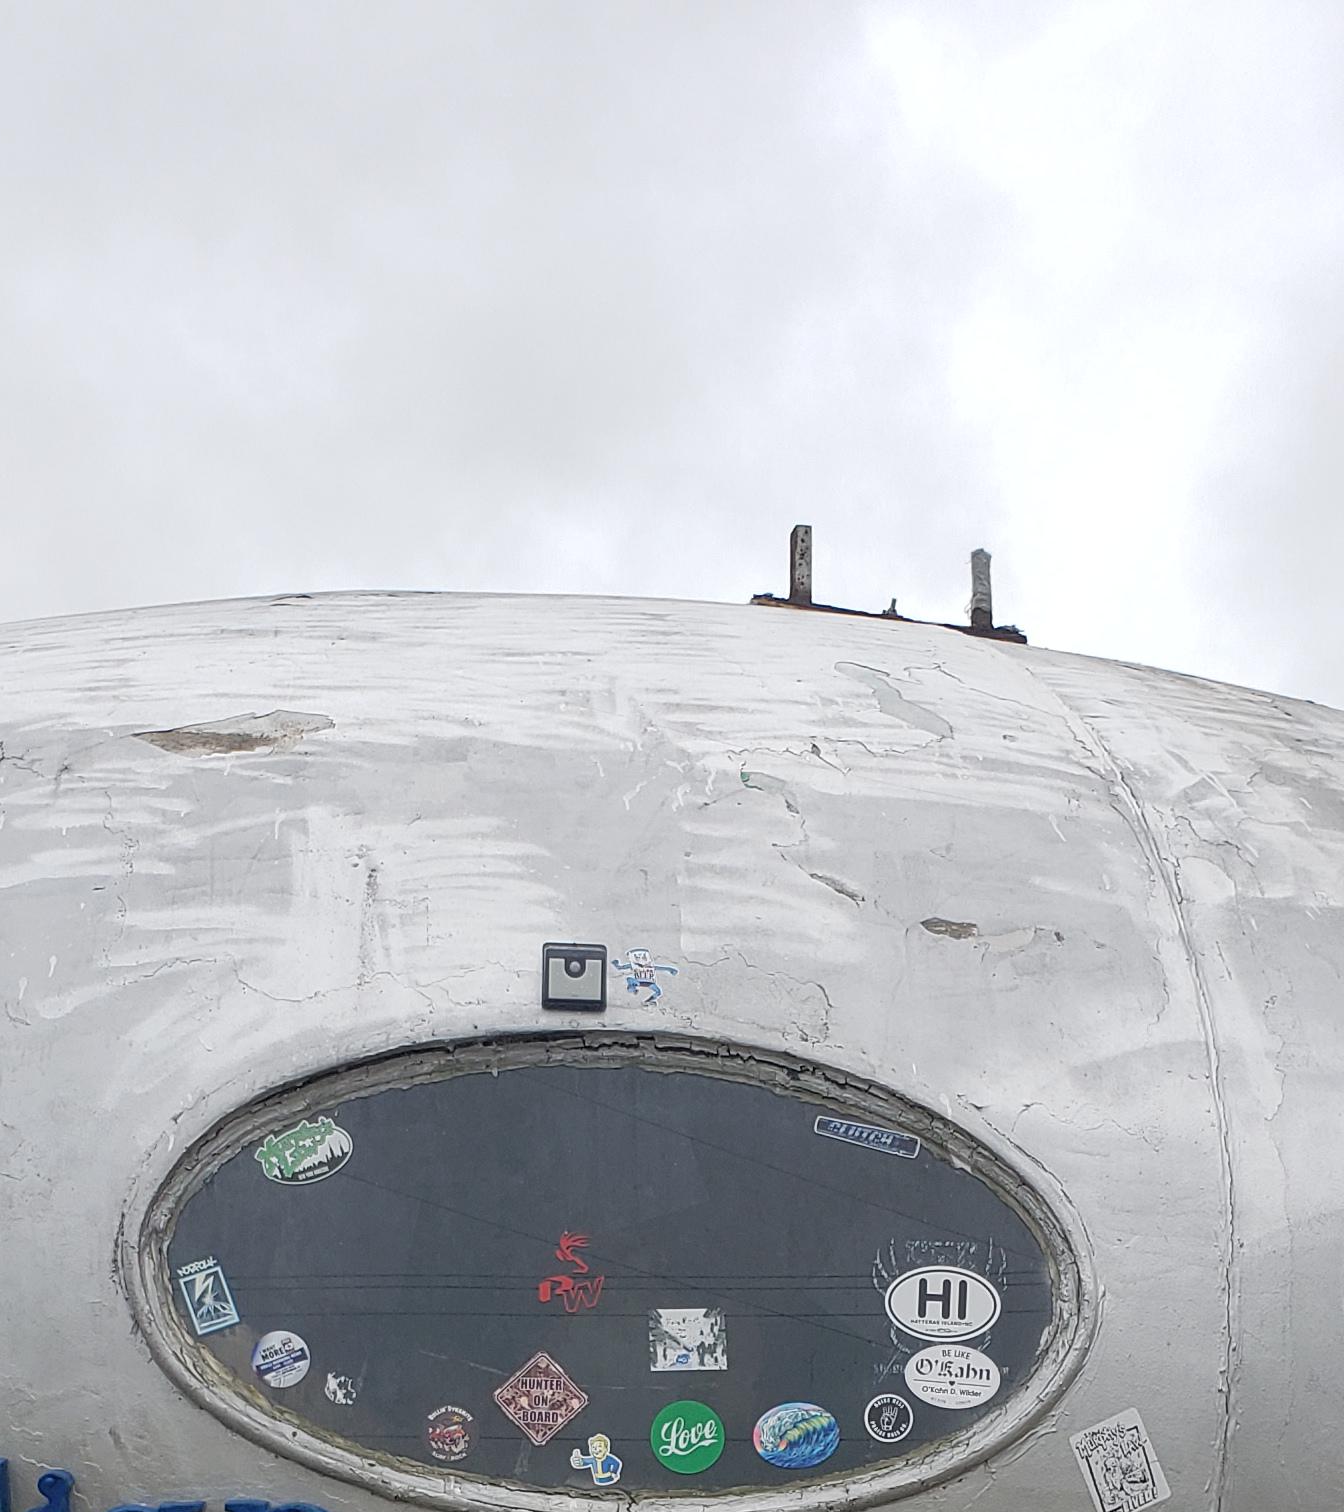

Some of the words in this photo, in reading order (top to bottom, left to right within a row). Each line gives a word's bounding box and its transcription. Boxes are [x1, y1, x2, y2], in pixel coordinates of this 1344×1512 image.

[918, 1278, 968, 1320] HI
[261, 1347, 284, 1361] MORE
[942, 1349, 952, 1357] BE
[954, 1350, 971, 1360] LIKE
[916, 1358, 991, 1380] O'Kahn
[520, 1378, 562, 1390] HUNTER
[921, 1386, 949, 1395] O'Kahn
[959, 1389, 982, 1397] Wilder
[533, 1395, 548, 1406] ON
[522, 1411, 559, 1423] BOARD
[659, 1417, 718, 1457] Love
